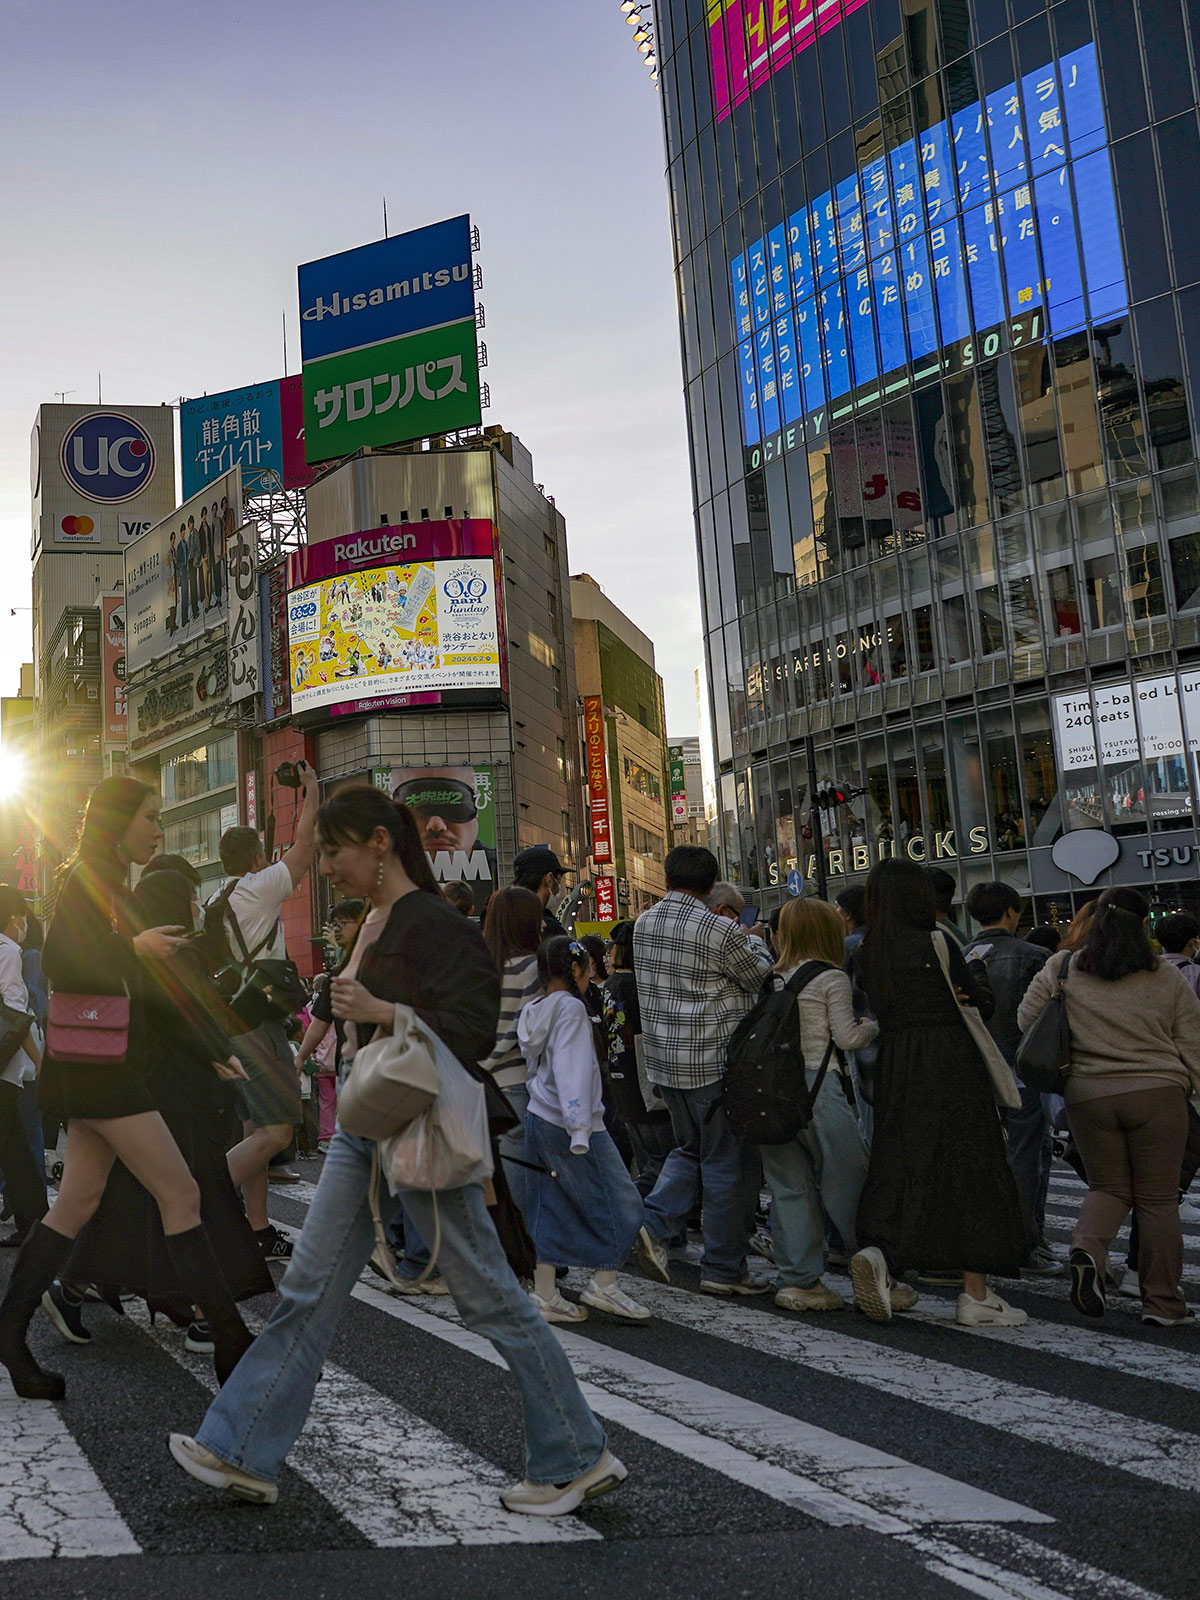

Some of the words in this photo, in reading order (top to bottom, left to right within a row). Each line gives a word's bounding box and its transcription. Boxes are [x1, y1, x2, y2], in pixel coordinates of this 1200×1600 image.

[302, 263, 469, 322] Hisamitsu
[313, 354, 468, 429] サロンパス
[202, 407, 260, 446] 龍角散
[195, 437, 273, 475] ダイレクト
[121, 521, 152, 536] VIS
[334, 532, 416, 562] Rakuten
[290, 589, 318, 605] 渋谷区が
[443, 604, 490, 616] Sunday
[228, 531, 258, 692] もんじゃ
[290, 602, 317, 621] まるごと
[443, 631, 495, 642] 渋谷おとなり
[443, 642, 476, 652] サンデー
[776, 652, 821, 680] SARE
[827, 627, 894, 663] LONGE
[358, 700, 385, 709] Rakuten
[386, 697, 407, 706] Vision
[1063, 687, 1158, 714] Time-baed
[1065, 714, 1093, 729] 240
[587, 700, 604, 792] クスリのことなら
[1068, 744, 1097, 755] SHIBUY
[1104, 738, 1138, 748] TSUTAYA
[471, 772, 493, 809] 再び
[1152, 808, 1179, 817] rossing
[1180, 806, 1193, 814] vie
[591, 798, 610, 857] 三千里
[425, 850, 492, 880] MM
